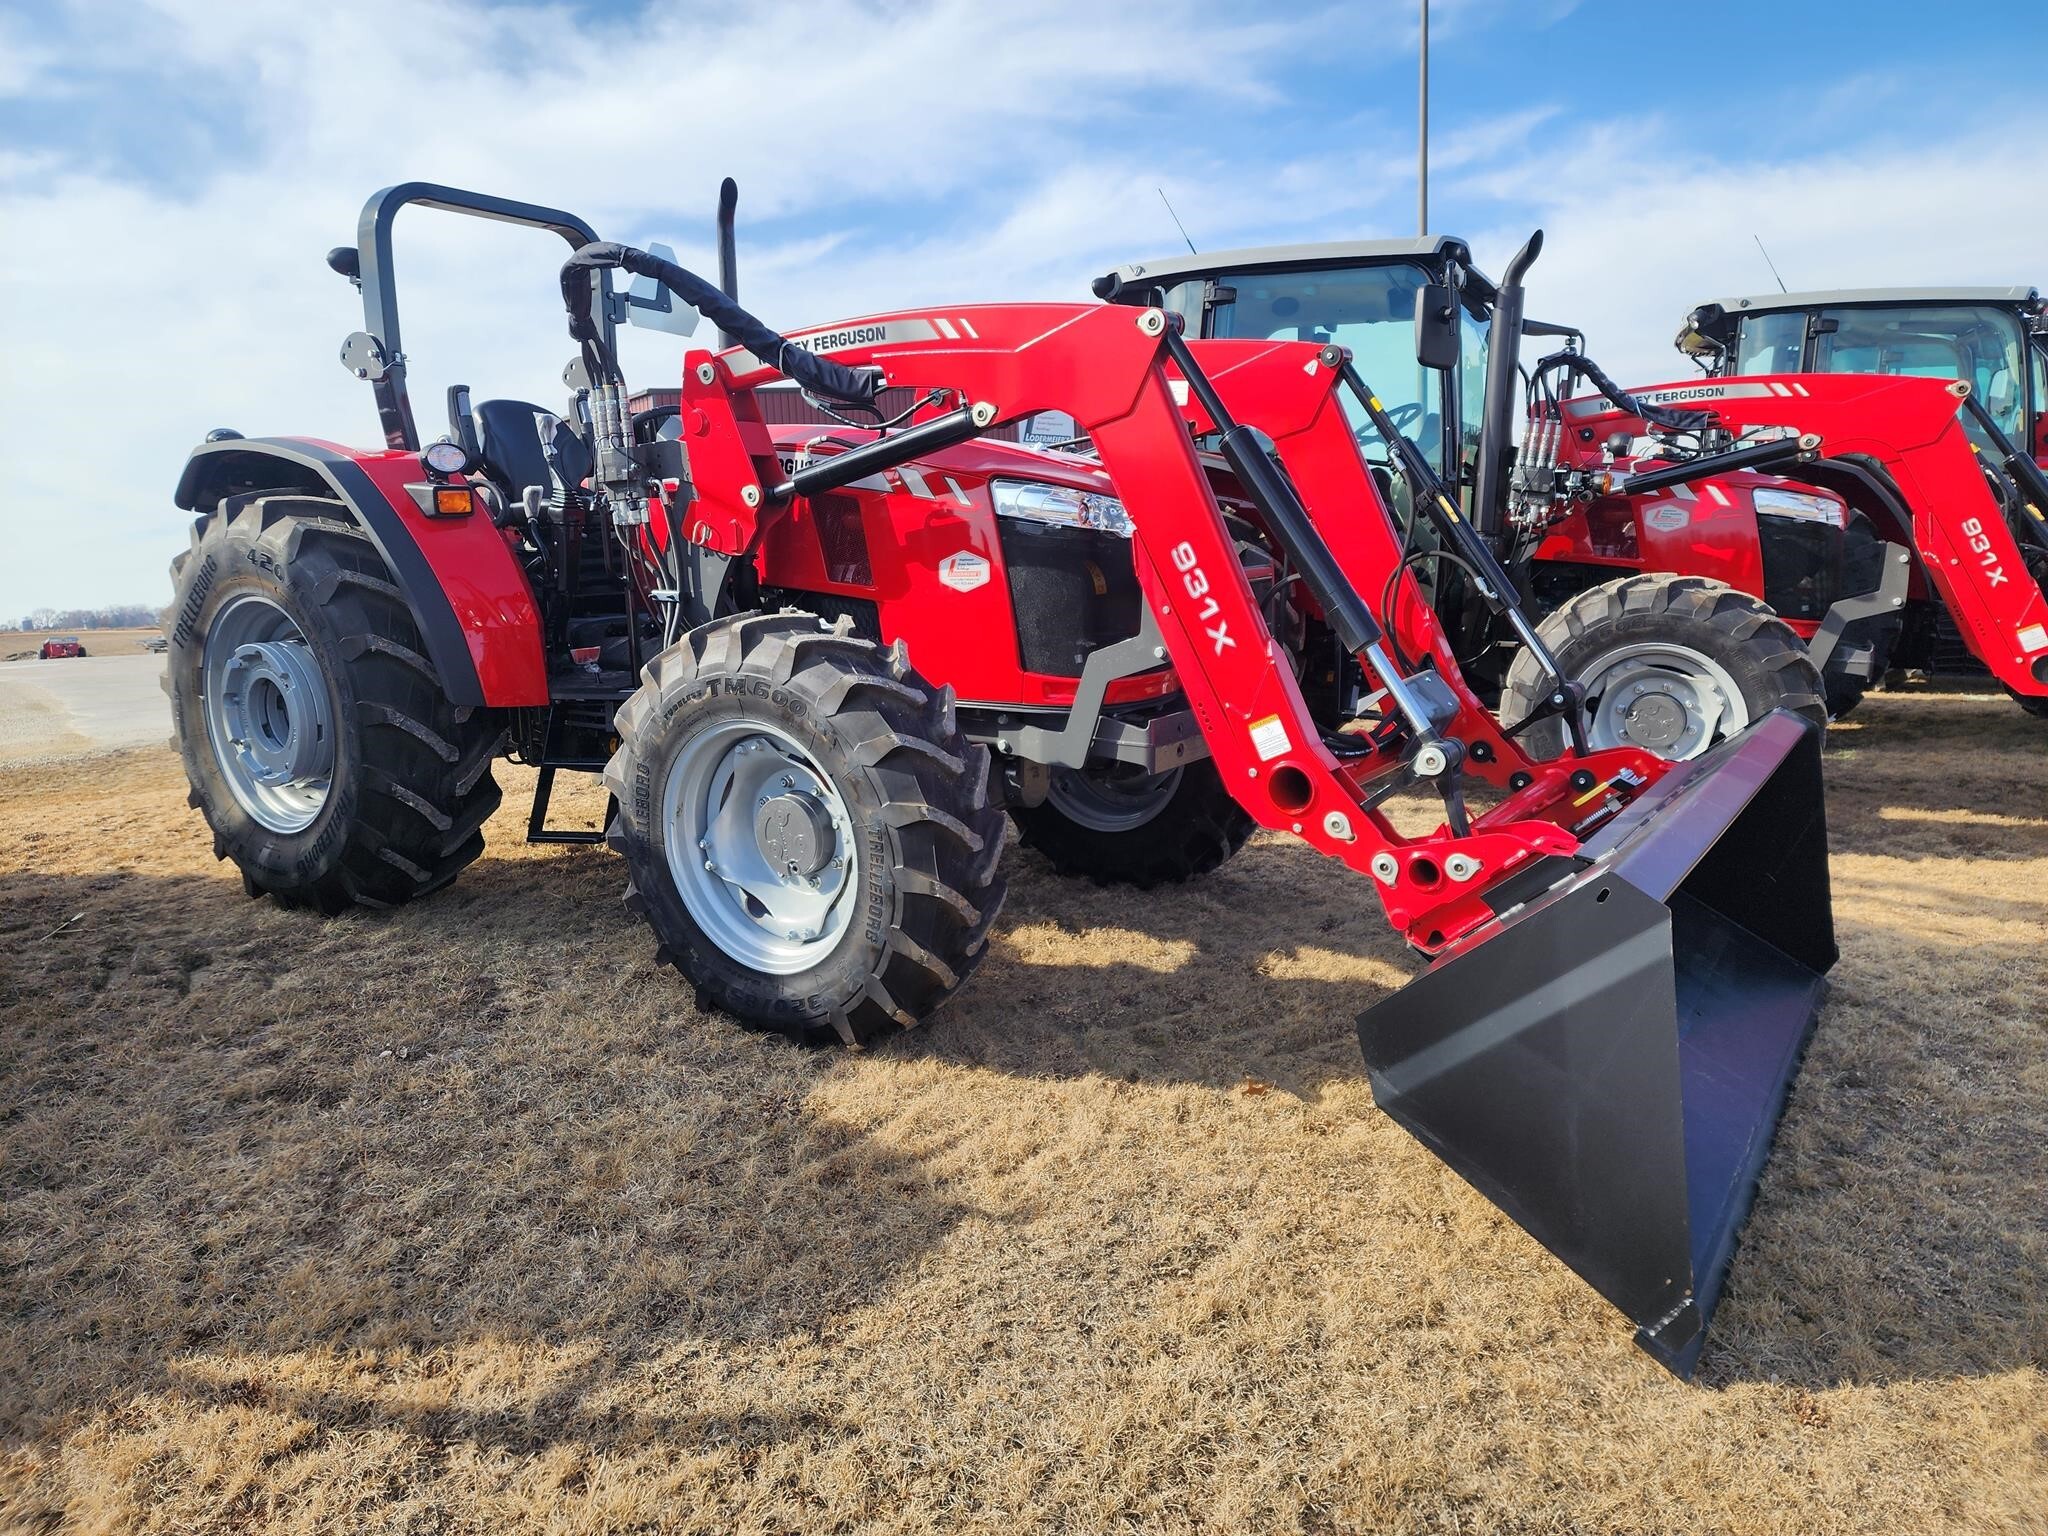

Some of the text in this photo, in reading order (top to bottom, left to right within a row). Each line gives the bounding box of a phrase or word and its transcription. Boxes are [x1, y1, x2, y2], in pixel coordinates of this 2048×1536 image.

[814, 326, 886, 352] FERGUSON
[1655, 387, 1725, 403] FERGUSON
[1961, 517, 2009, 588] 931X
[173, 553, 218, 651] TRELLEBORG
[1170, 541, 1237, 657] 931X
[865, 828, 887, 945] TRELLEBORG
